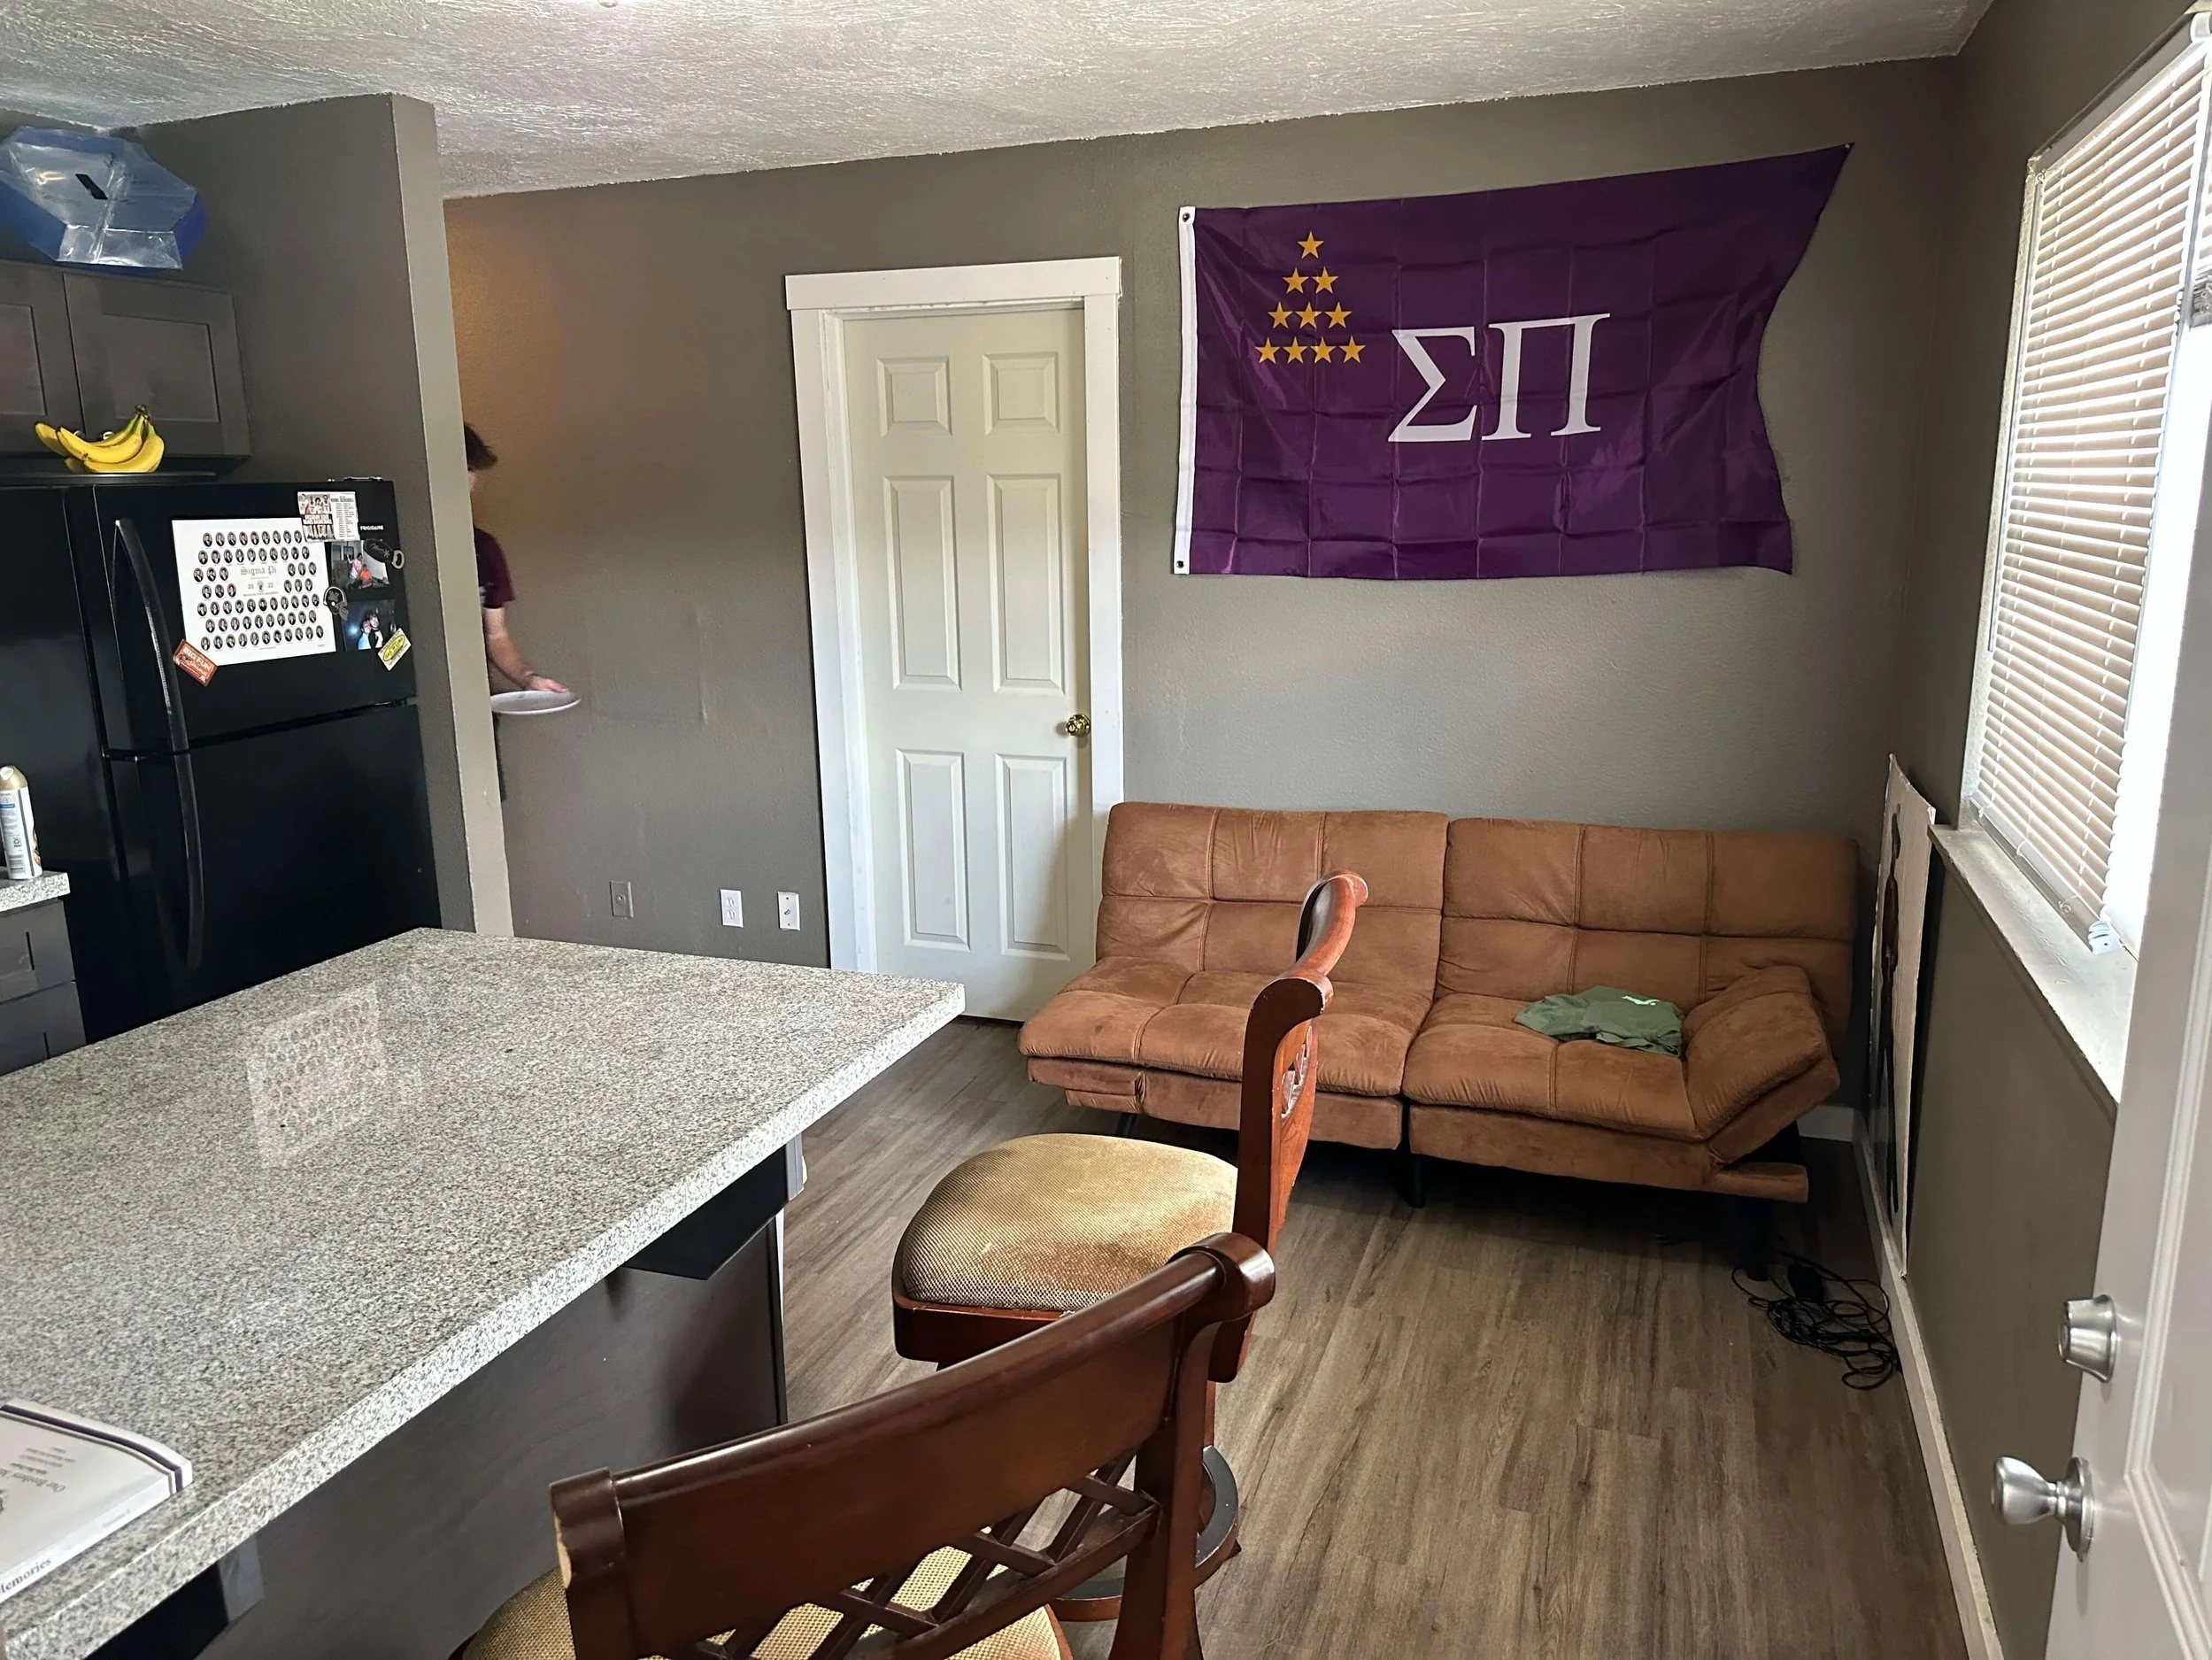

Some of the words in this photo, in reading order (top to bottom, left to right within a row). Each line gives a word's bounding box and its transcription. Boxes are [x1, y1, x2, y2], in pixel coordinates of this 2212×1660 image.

[1388, 313, 1610, 442] ΣΠ
[240, 567, 266, 575] Sigma
[267, 565, 277, 575] Pi
[182, 646, 197, 660] BIG
[197, 657, 212, 671] FUN
